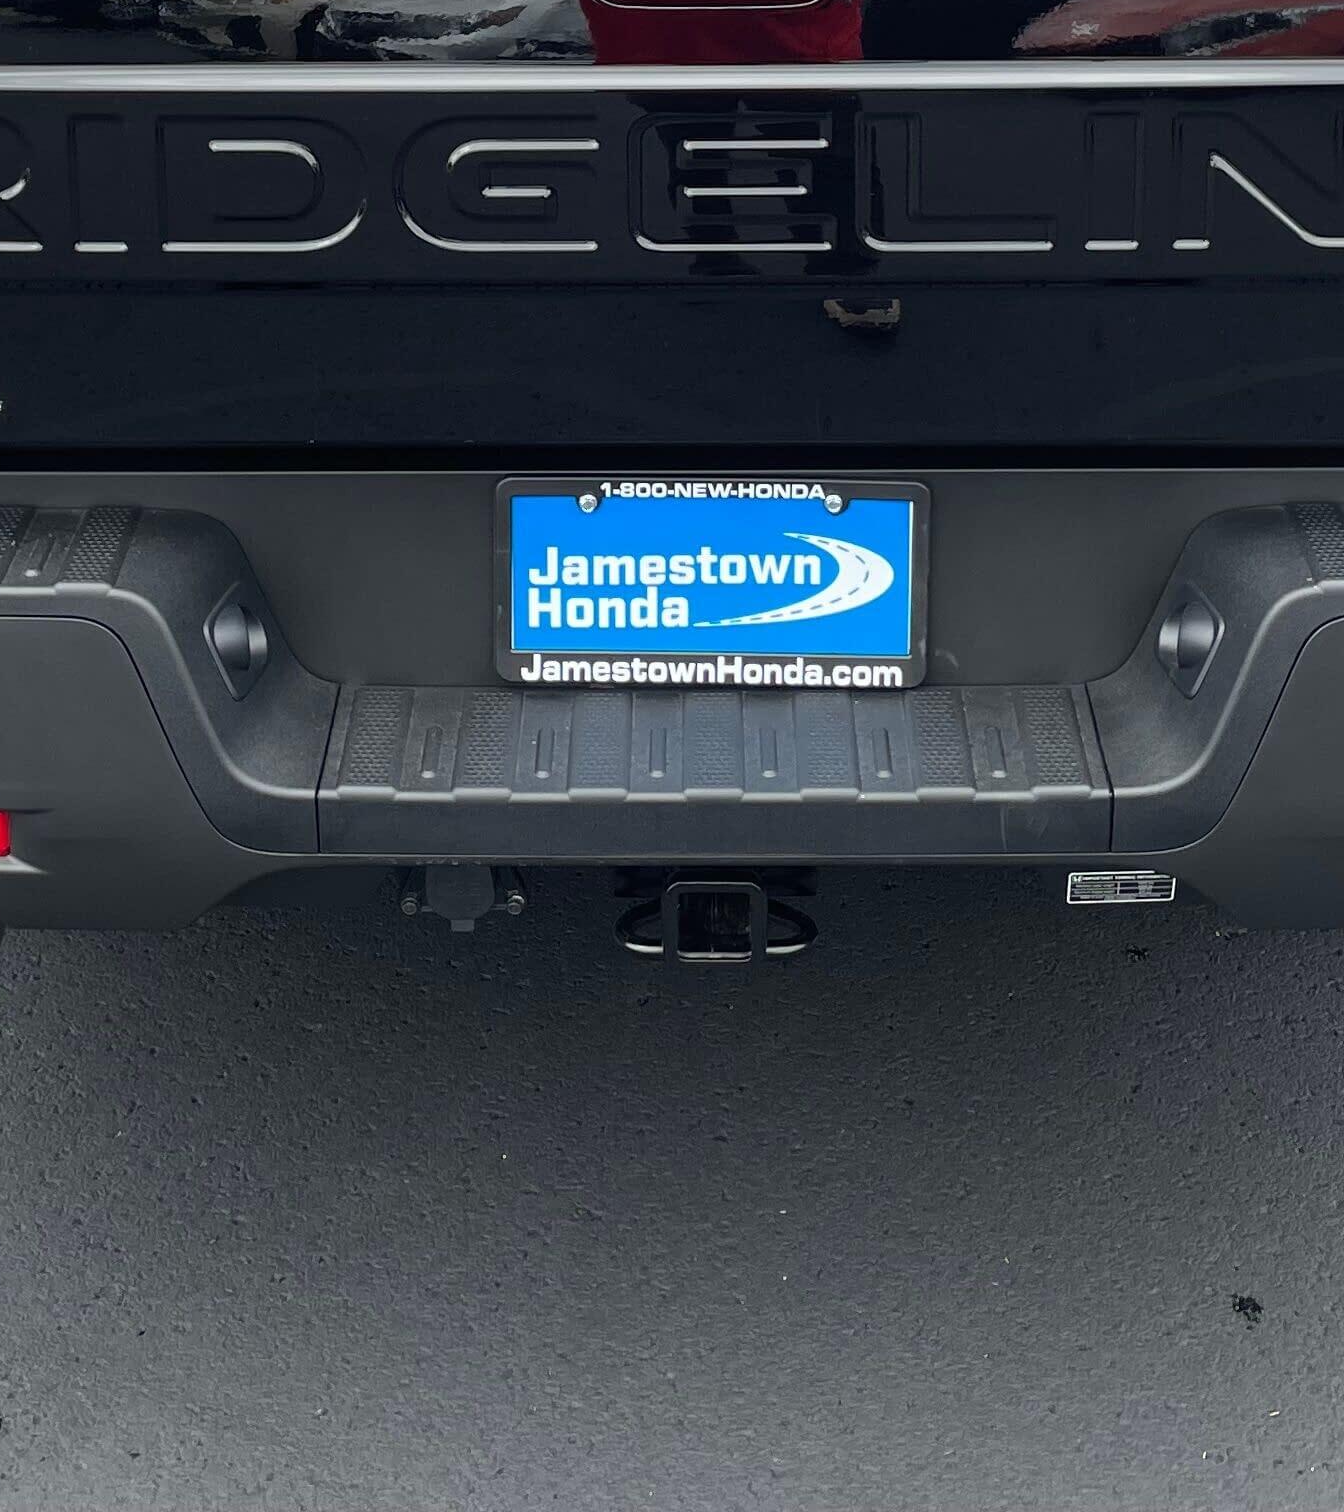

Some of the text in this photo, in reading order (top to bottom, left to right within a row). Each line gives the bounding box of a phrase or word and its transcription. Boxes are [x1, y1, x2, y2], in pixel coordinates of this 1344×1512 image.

[599, 482, 826, 500] 1-800-NEW-HONDA
[528, 546, 822, 587] Jamestown
[528, 585, 690, 629] Honda
[520, 653, 903, 688] JamestownHonda.com
